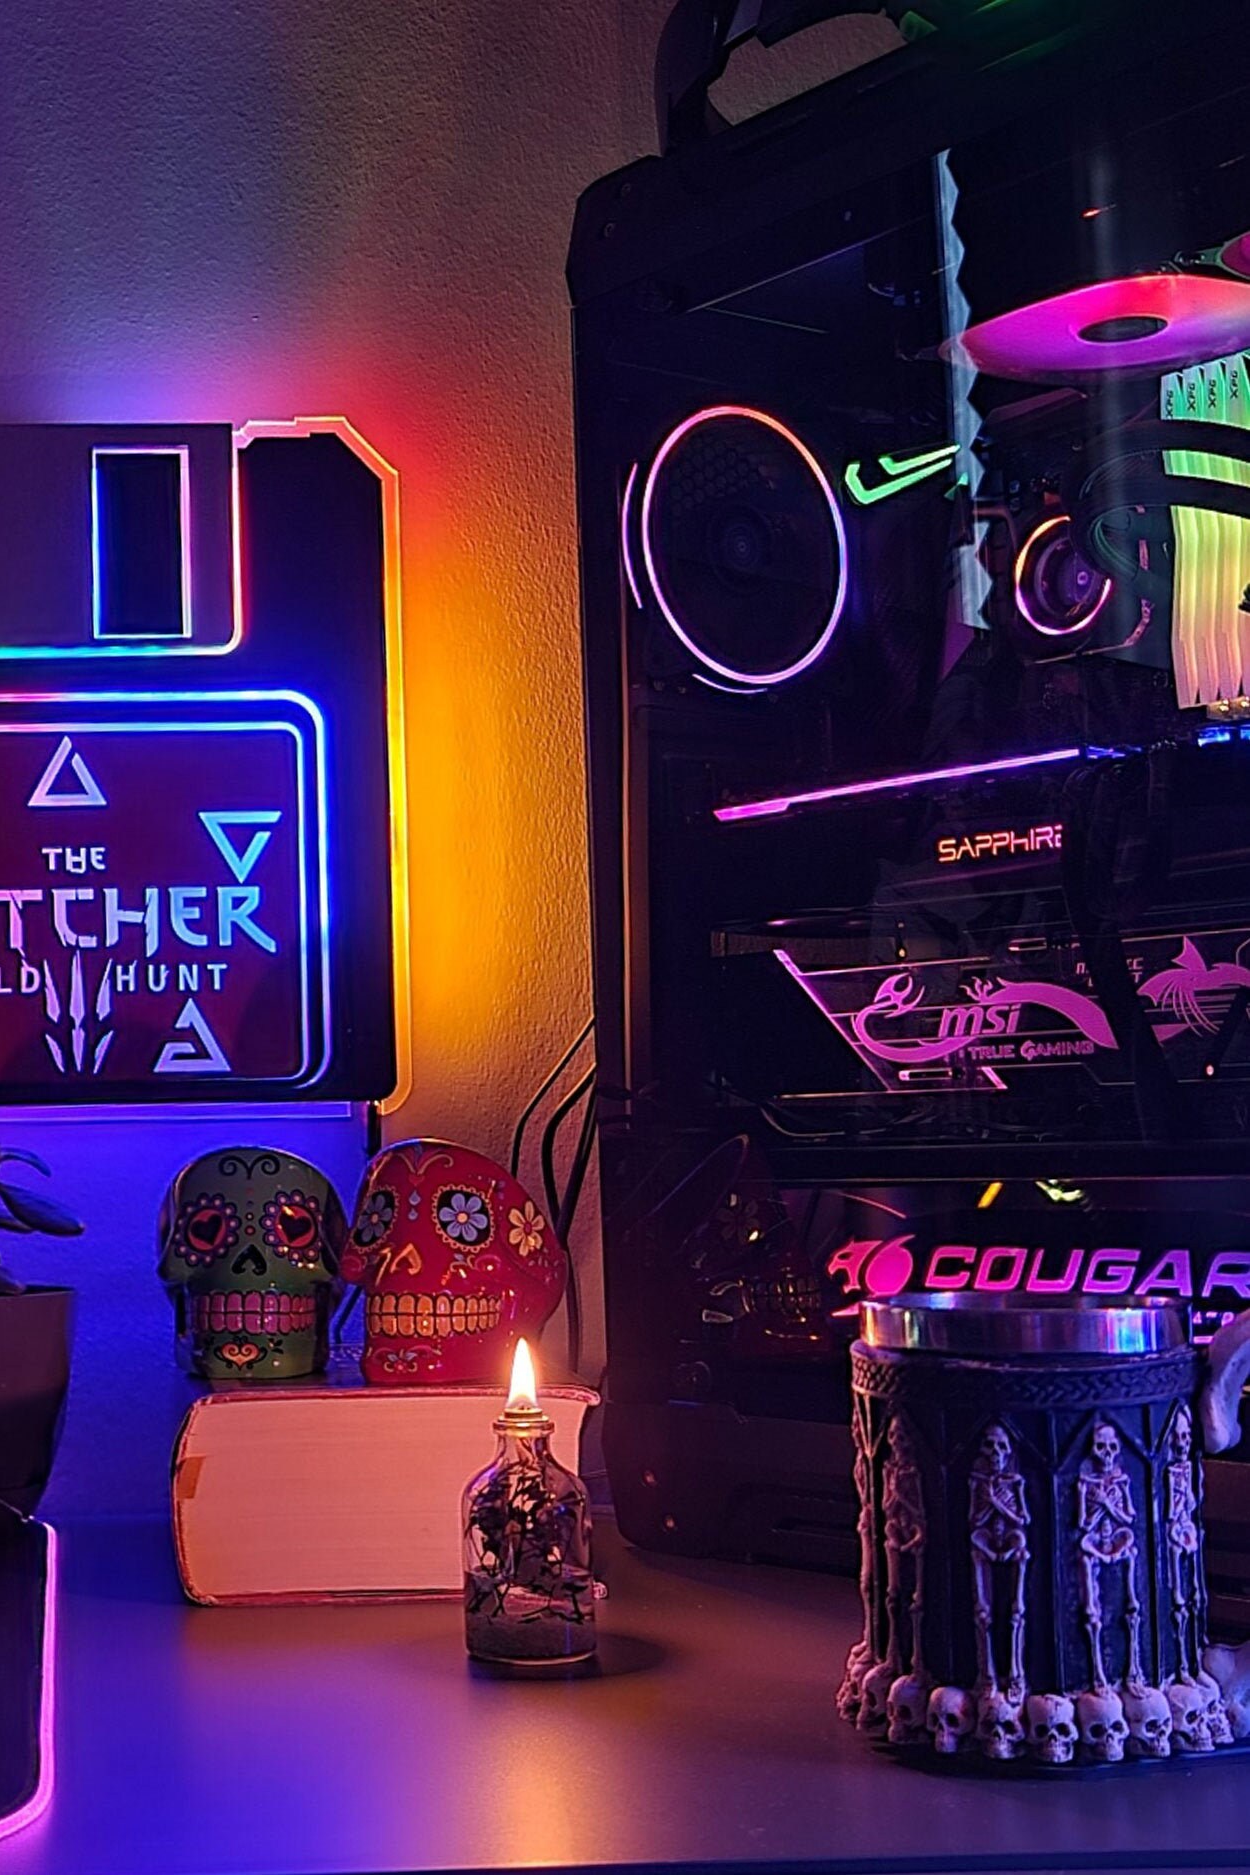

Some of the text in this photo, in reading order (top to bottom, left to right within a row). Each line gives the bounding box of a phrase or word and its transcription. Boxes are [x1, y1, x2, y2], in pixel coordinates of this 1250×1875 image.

[1208, 379, 1217, 408] XPG
[42, 847, 106, 873] THE
[115, 962, 228, 993] HUNT
[938, 1003, 1022, 1037] msi
[968, 1044, 1016, 1060] TRUE
[924, 1246, 1250, 1297] COUGAR
